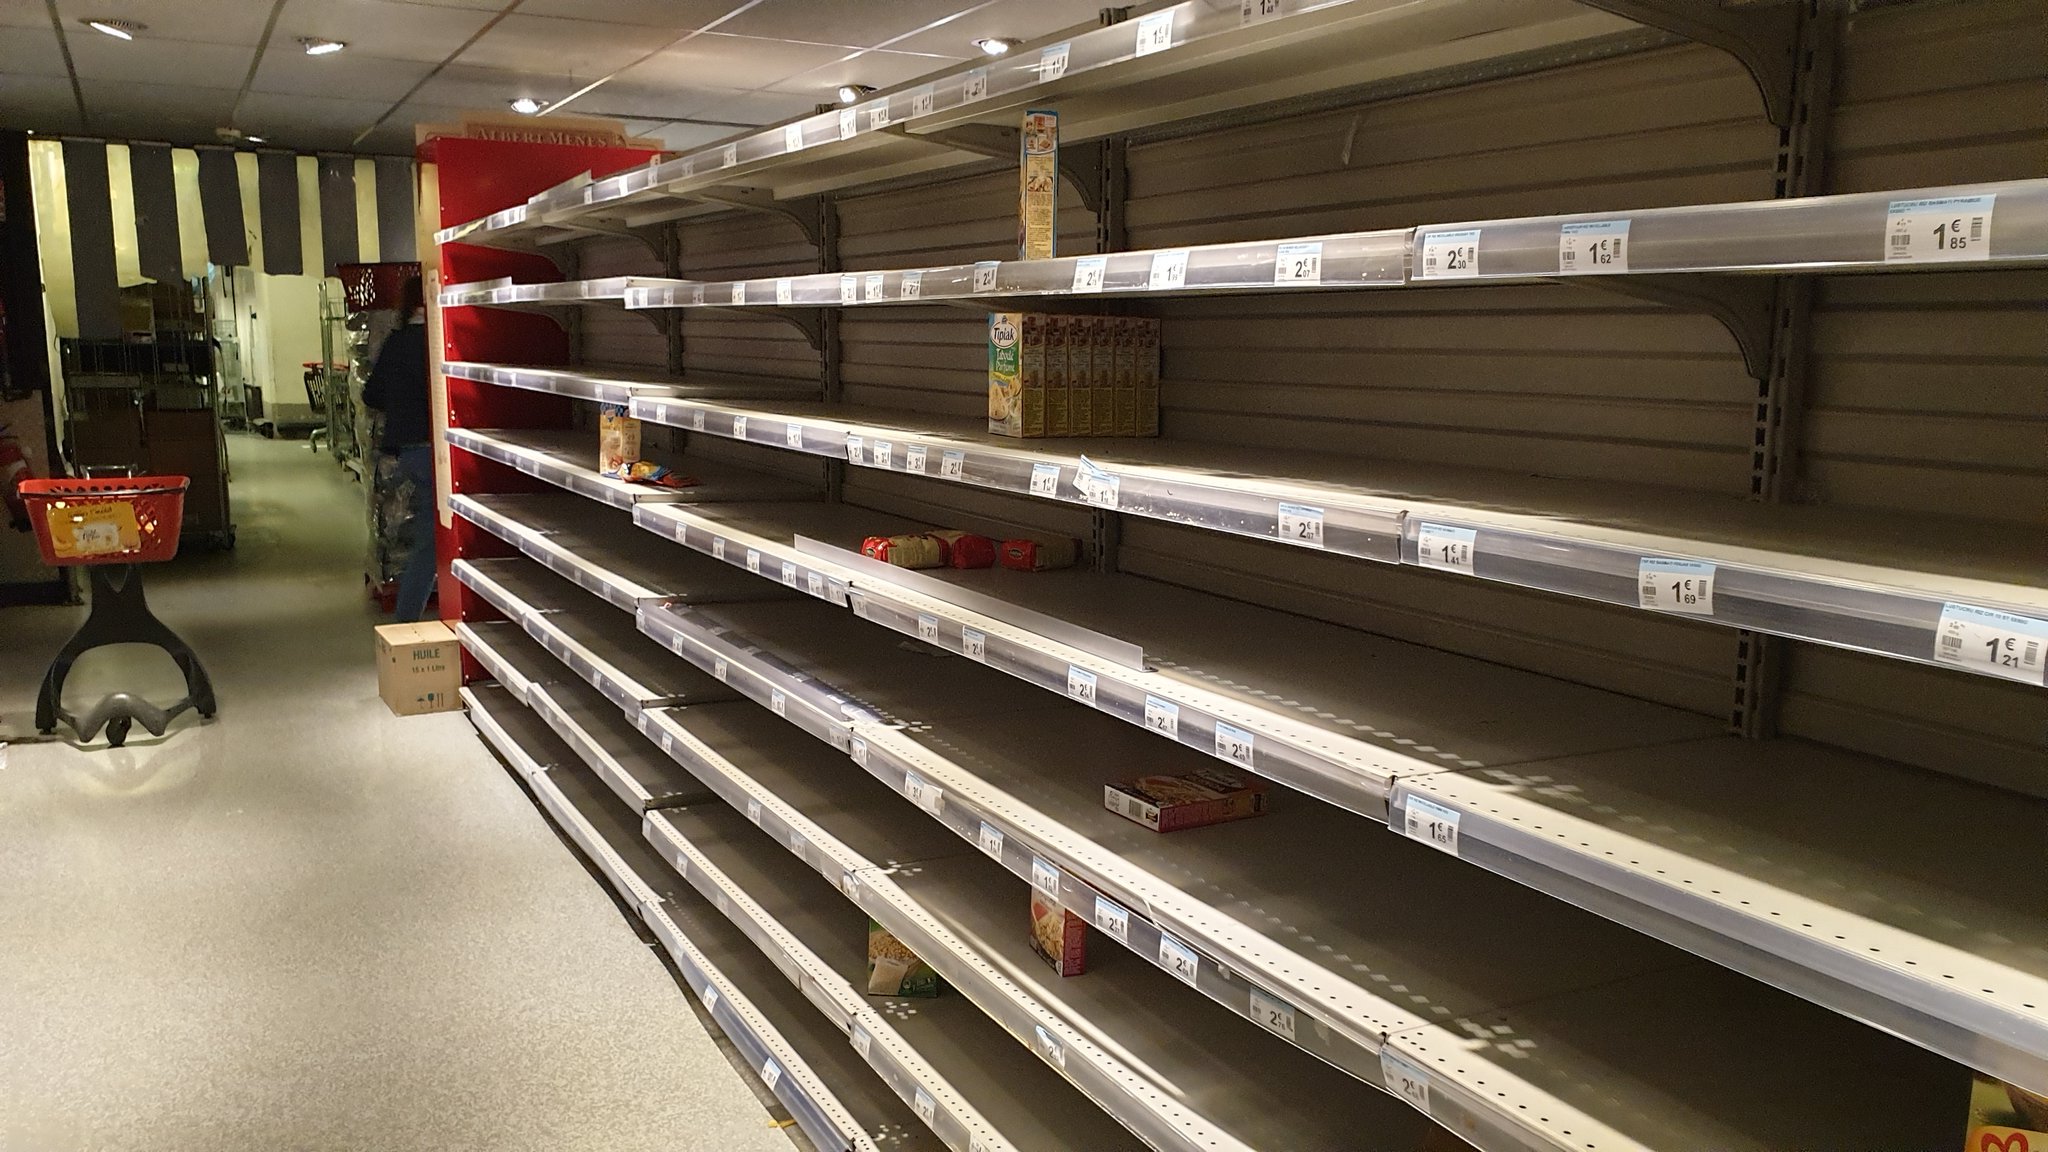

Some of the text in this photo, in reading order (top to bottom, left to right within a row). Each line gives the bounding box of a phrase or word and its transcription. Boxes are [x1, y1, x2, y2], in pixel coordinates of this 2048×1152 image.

[1933, 224, 1946, 250] 1
[1950, 237, 1967, 249] 85
[1447, 250, 1457, 270] 2
[1589, 243, 1598, 264] 1
[1600, 254, 1611, 264] 62
[1295, 260, 1303, 278] 2
[994, 328, 1014, 344] Tipiak
[1299, 522, 1306, 538] 2
[1442, 545, 1448, 563] 1
[1672, 581, 1680, 602] 1
[1684, 594, 1696, 604] 69
[413, 648, 440, 660] HUILE
[1986, 638, 2000, 663] 1
[2003, 655, 2019, 668] 21
[1232, 744, 1239, 758] 2
[1429, 822, 1435, 839] 1
[1270, 1011, 1278, 1026] 2
